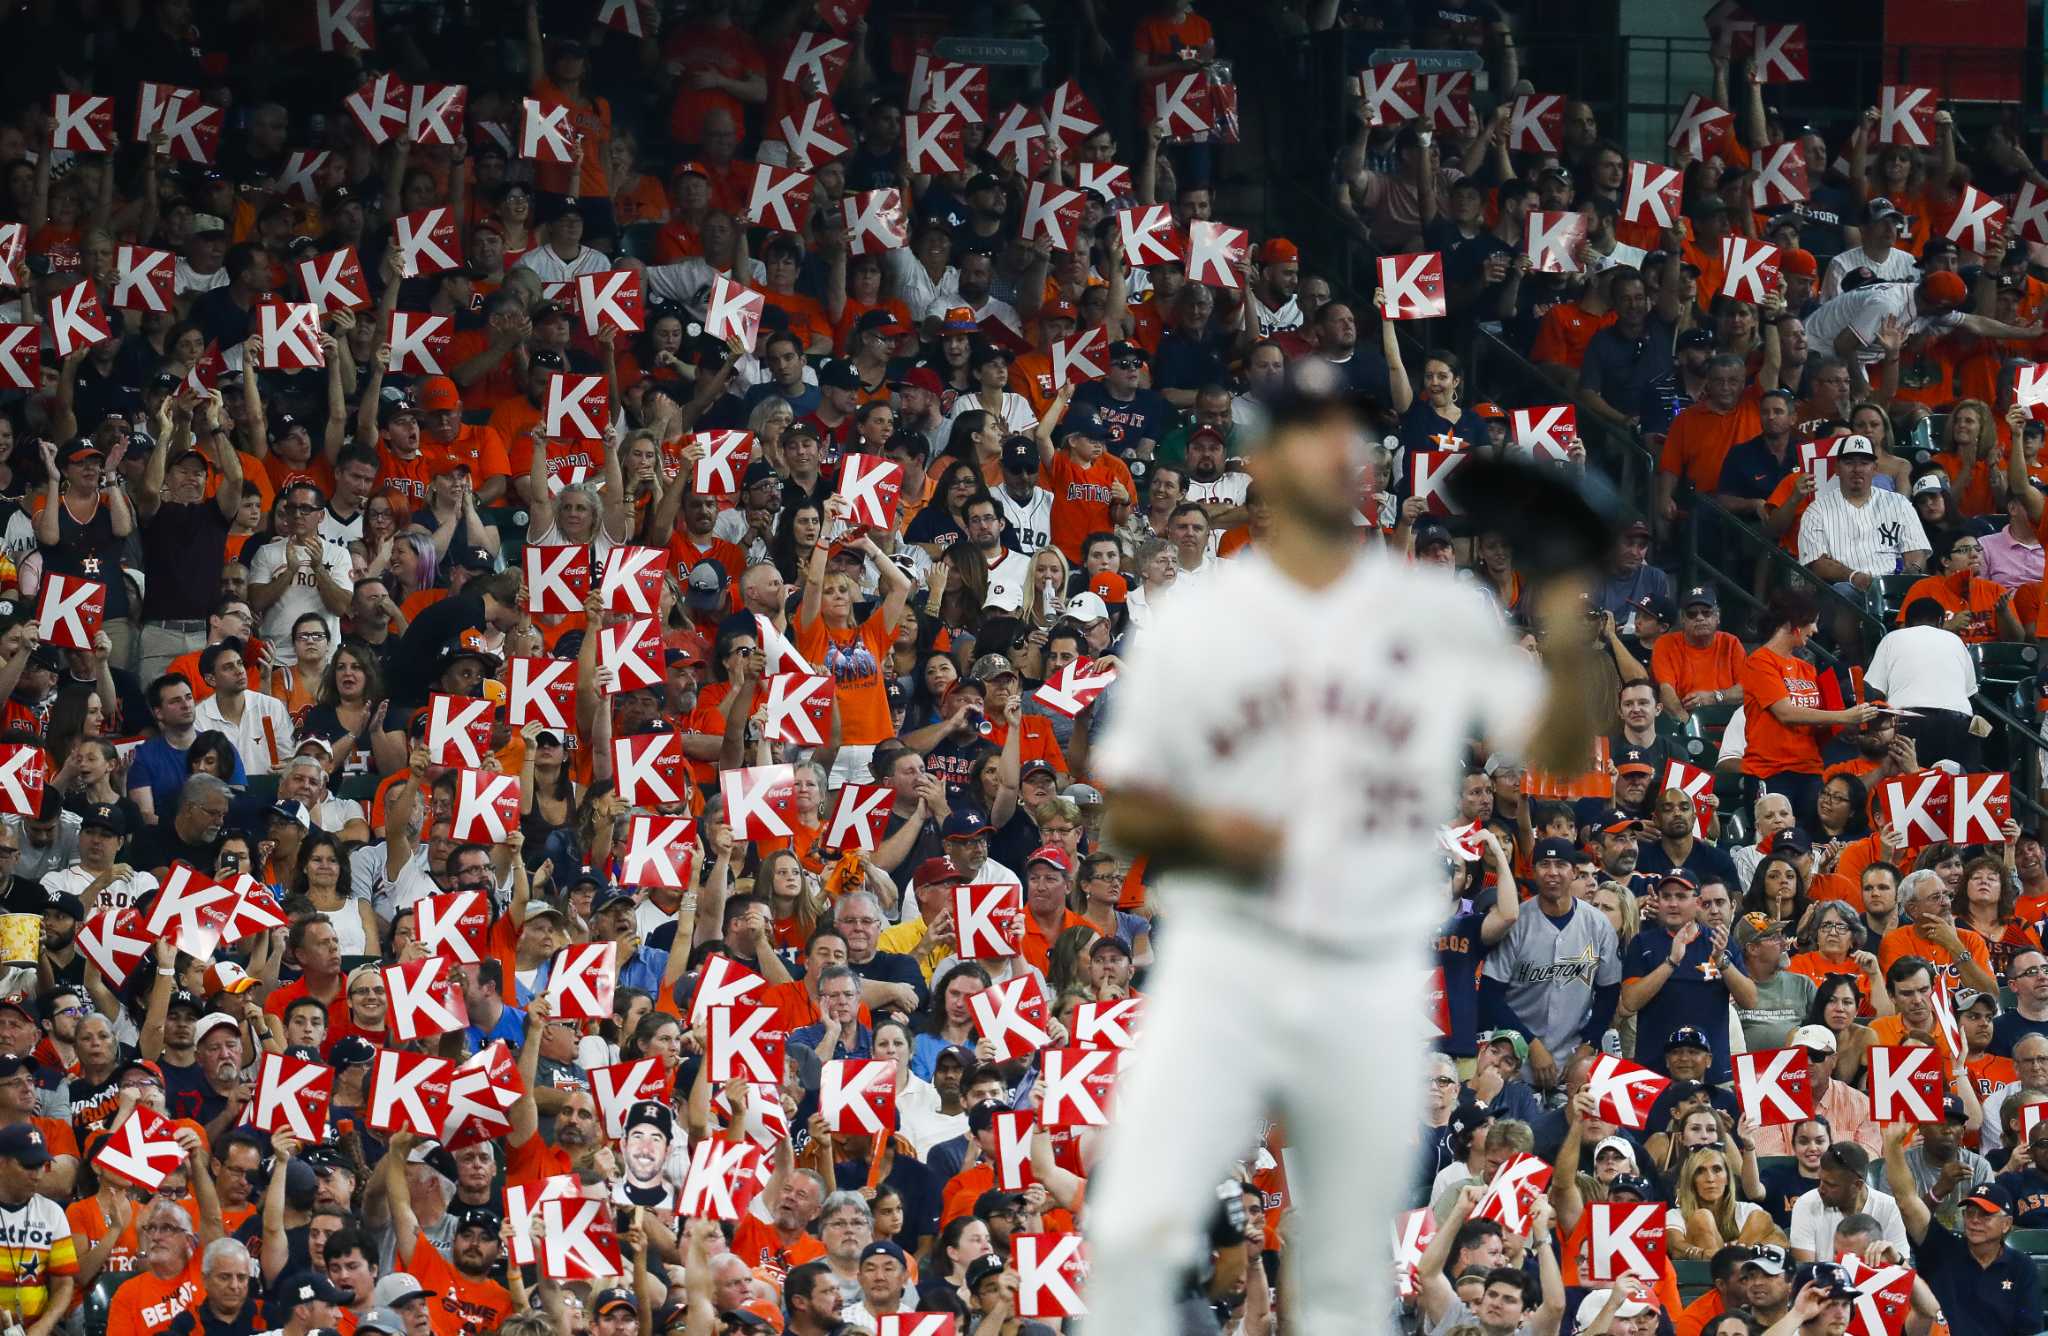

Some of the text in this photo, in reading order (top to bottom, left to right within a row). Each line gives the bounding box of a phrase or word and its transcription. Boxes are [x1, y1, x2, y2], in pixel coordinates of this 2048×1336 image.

[1755, 25, 1804, 81] K
[53, 94, 108, 151] K
[347, 74, 406, 144] K
[408, 85, 457, 144] K
[928, 68, 983, 122] K
[1155, 73, 1210, 138] K
[1362, 62, 1418, 125] K
[1424, 71, 1467, 129] K
[1511, 96, 1560, 152] K
[1669, 94, 1730, 162] K
[1880, 86, 1931, 145] K
[523, 97, 572, 162] K
[781, 99, 848, 172] K
[906, 114, 959, 173] K
[747, 164, 810, 232] K
[1625, 162, 1679, 228] K
[1752, 142, 1806, 208] K
[396, 208, 458, 278] K
[844, 187, 902, 254] K
[1023, 181, 1081, 250] K
[1119, 206, 1179, 265] K
[1528, 212, 1578, 272] K
[1946, 186, 2003, 253] K
[113, 246, 170, 311] K
[301, 248, 363, 313] K
[1189, 221, 1245, 288] K
[1382, 254, 1437, 319] K
[52, 280, 107, 356] K
[579, 272, 639, 335] K
[704, 273, 764, 348] K
[390, 313, 448, 374] K
[1052, 328, 1105, 390] K
[546, 374, 602, 439] K
[696, 430, 748, 493] K
[838, 453, 898, 527] K
[40, 575, 100, 649] K
[527, 546, 584, 612] K
[599, 546, 663, 613] K
[601, 618, 662, 693] K
[1035, 656, 1116, 716] K
[510, 658, 572, 728] K
[766, 672, 822, 744] K
[428, 696, 491, 769] K
[615, 734, 679, 806] K
[726, 767, 794, 840] K
[453, 770, 512, 842] K
[827, 785, 892, 850] K
[1886, 775, 1947, 852] K
[1954, 774, 2006, 843] K
[624, 817, 690, 887] K
[147, 865, 233, 962] K
[419, 893, 480, 963] K
[956, 886, 1015, 957] K
[78, 914, 151, 986] K
[547, 942, 610, 1018] K
[386, 957, 464, 1040] K
[970, 976, 1051, 1062] K
[1076, 1000, 1139, 1048] K
[712, 1007, 777, 1081] K
[256, 1054, 327, 1143] K
[371, 1051, 447, 1135] K
[592, 1059, 656, 1138] K
[822, 1060, 884, 1134] K
[1043, 1050, 1109, 1125] K
[1591, 1057, 1664, 1127] K
[1737, 1049, 1808, 1125] K
[1872, 1047, 1938, 1121] K
[97, 1110, 188, 1187] K
[544, 1200, 617, 1278] K
[1592, 1204, 1659, 1280] K
[1016, 1235, 1088, 1316] K
[1840, 1253, 1907, 1336] K
